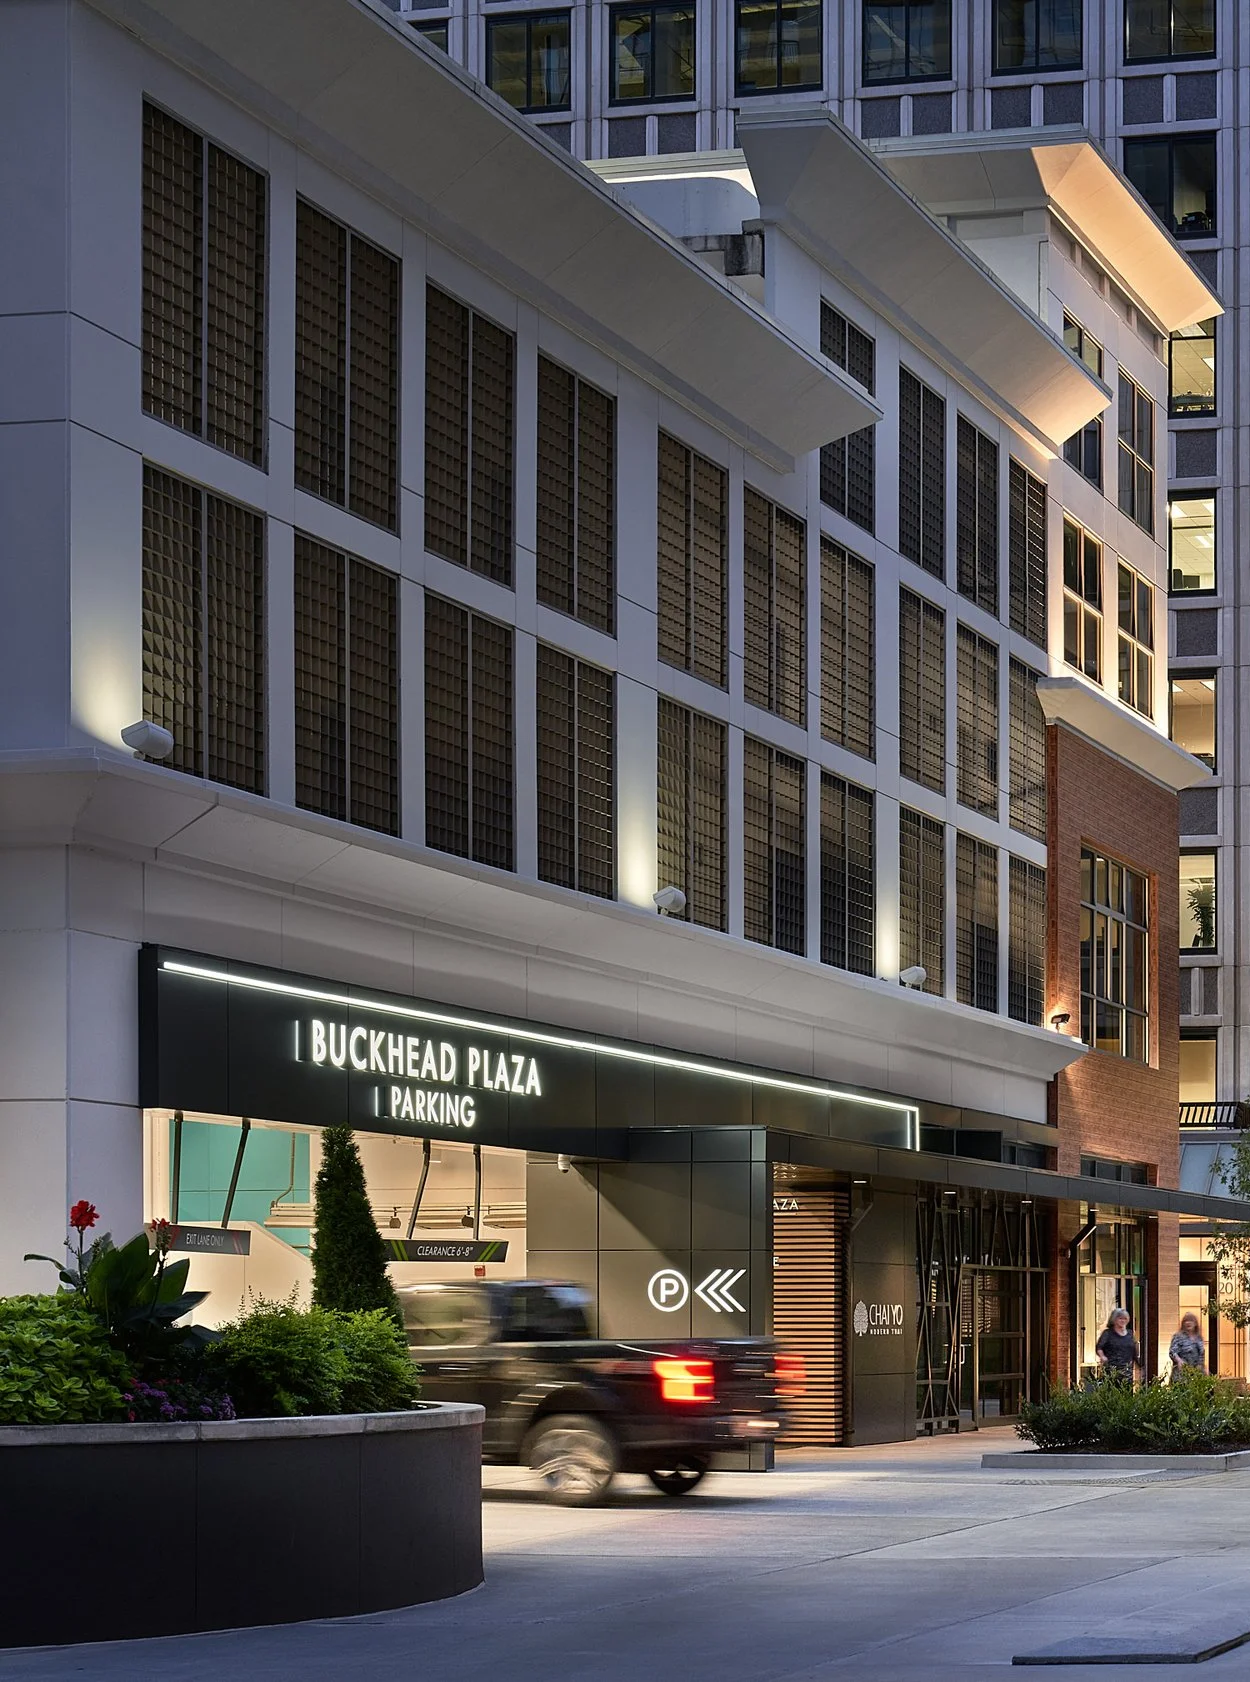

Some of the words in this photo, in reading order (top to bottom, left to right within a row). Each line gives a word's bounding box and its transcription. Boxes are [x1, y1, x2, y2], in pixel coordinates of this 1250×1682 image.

[312, 1019, 457, 1082] BUCKHEAD
[468, 1046, 542, 1096] PLAZA
[391, 1085, 476, 1128] PARKING
[186, 1233, 198, 1245] EXIT
[197, 1234, 211, 1246] LANE
[417, 1245, 456, 1257] CLEARANCE
[456, 1246, 474, 1257] 6'-8"
[660, 1278, 680, 1304] P
[869, 1304, 890, 1326] CHAI
[890, 1304, 904, 1326] YO
